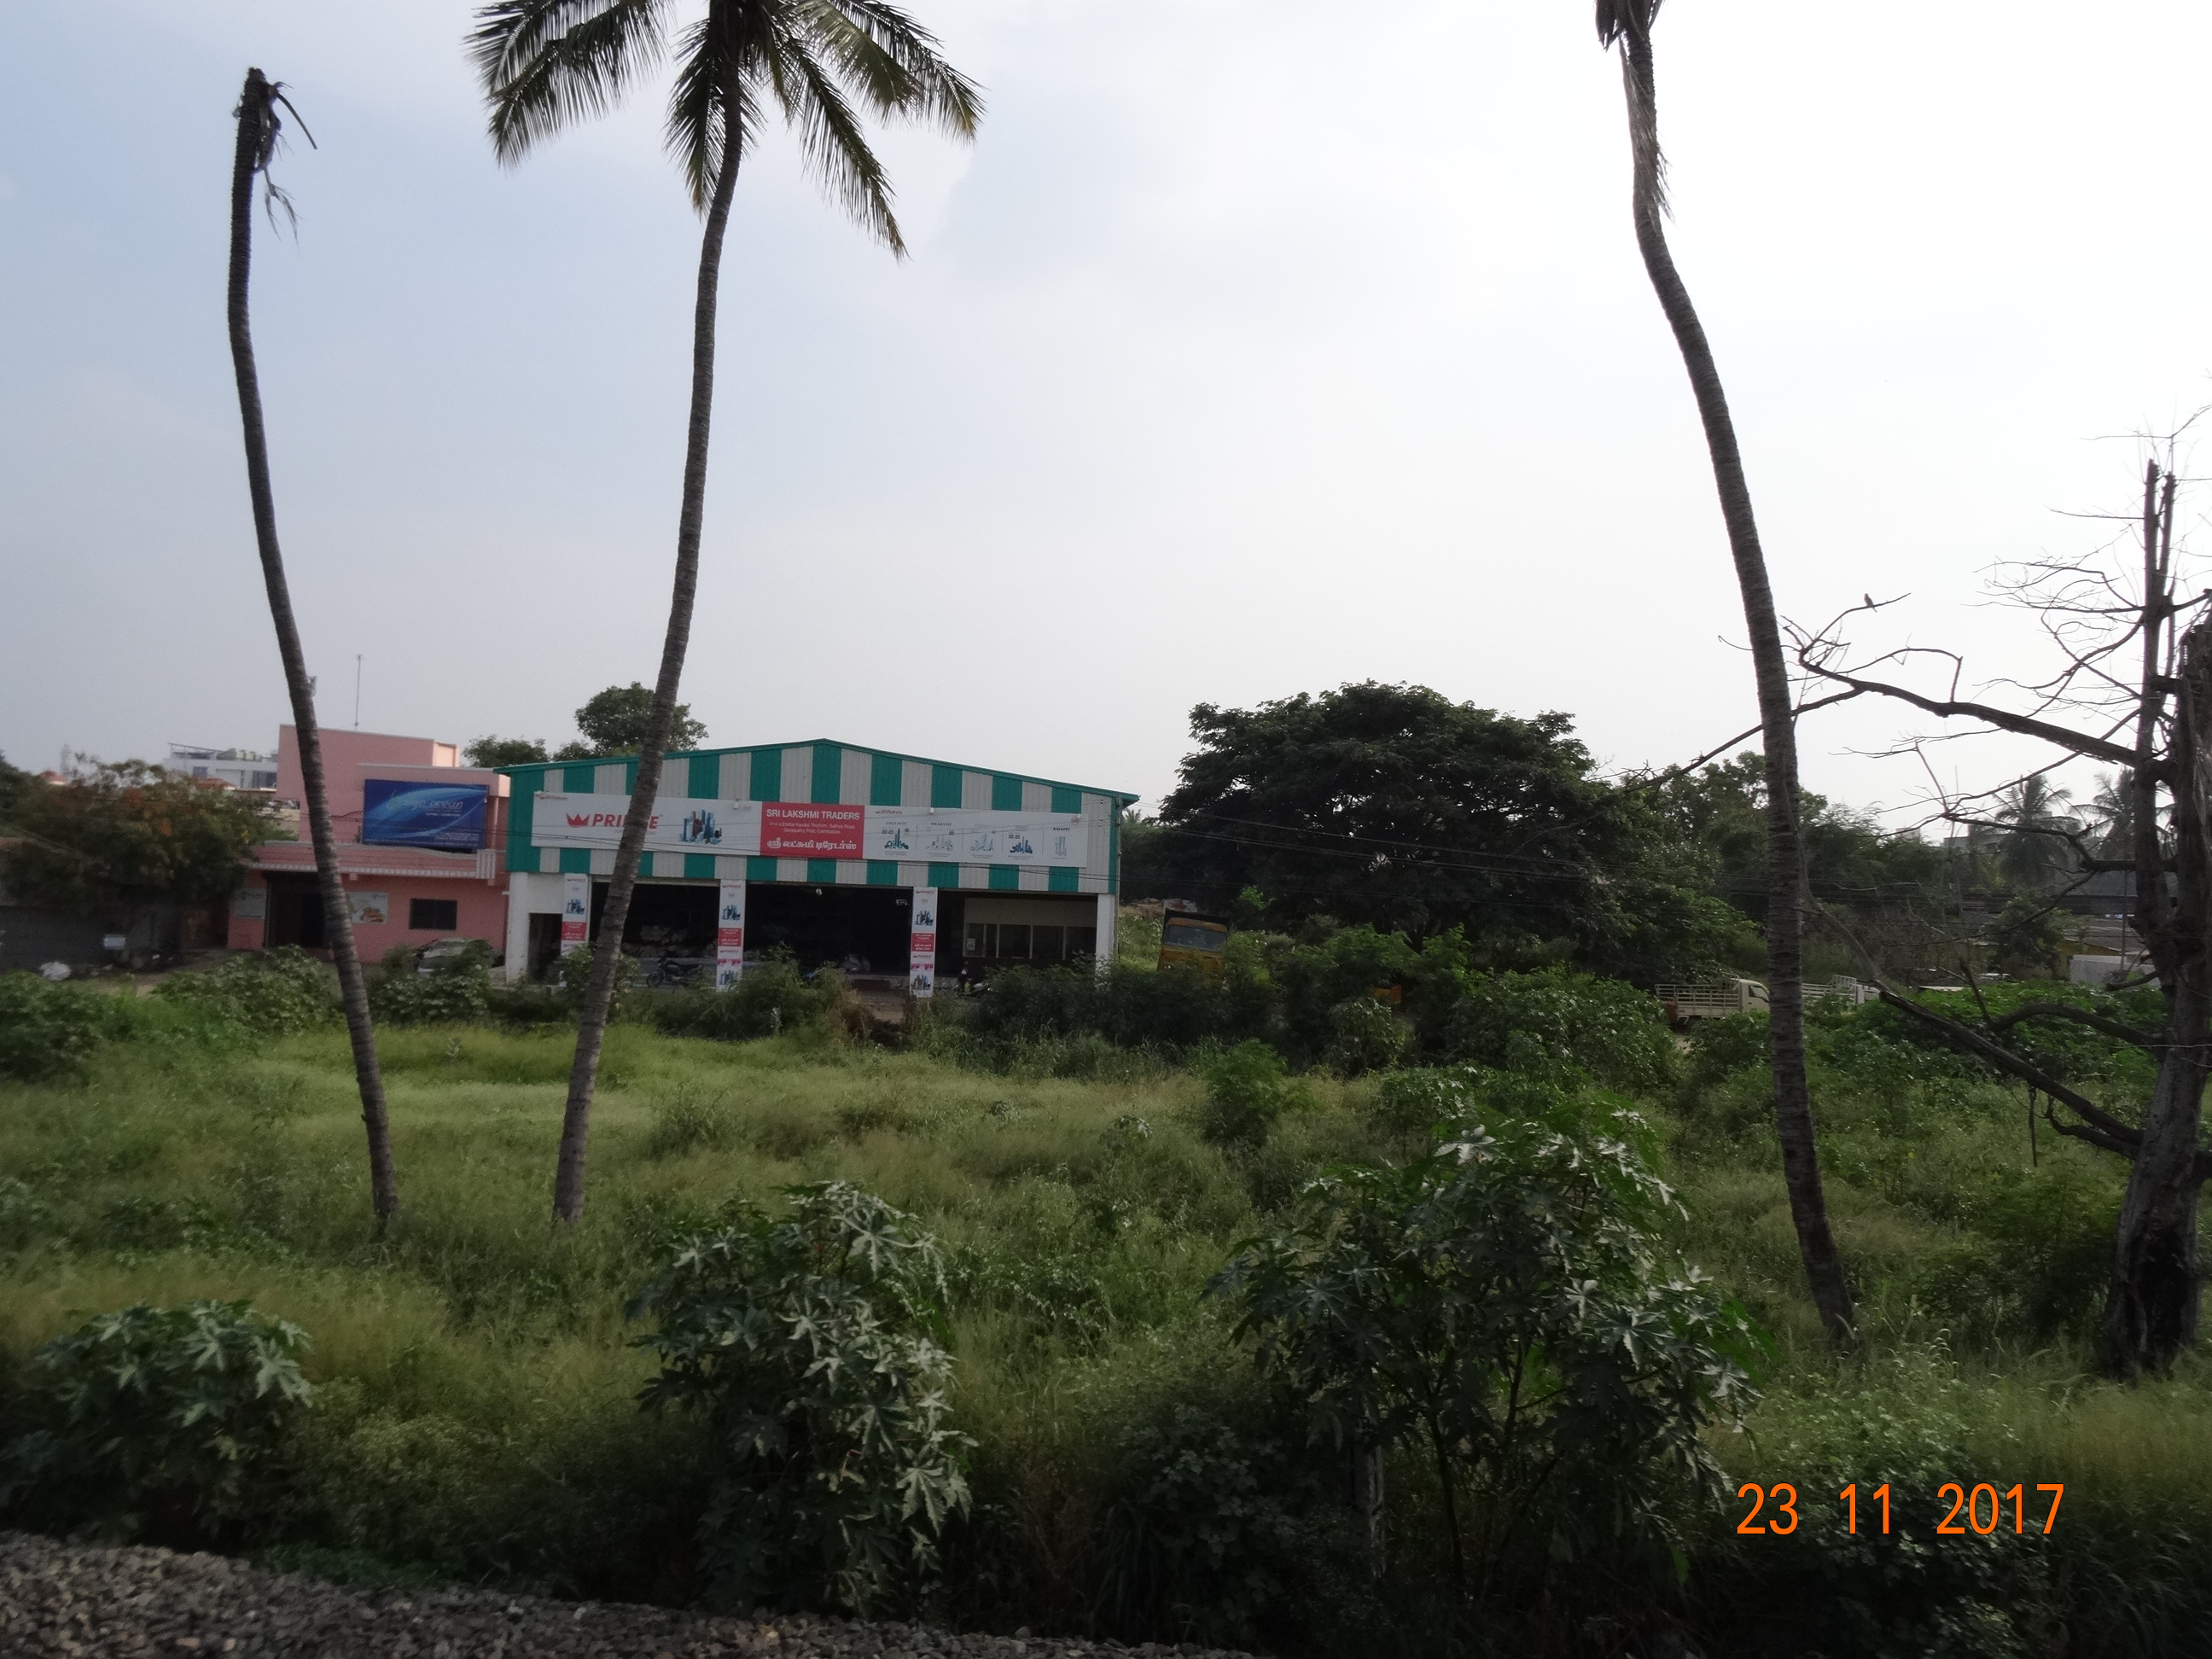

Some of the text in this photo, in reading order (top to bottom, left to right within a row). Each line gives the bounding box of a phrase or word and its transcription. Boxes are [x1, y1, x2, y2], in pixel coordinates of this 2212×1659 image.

[766, 808, 860, 820] SRI LAKSHMI TRADERS
[591, 813, 660, 830] PRIE
